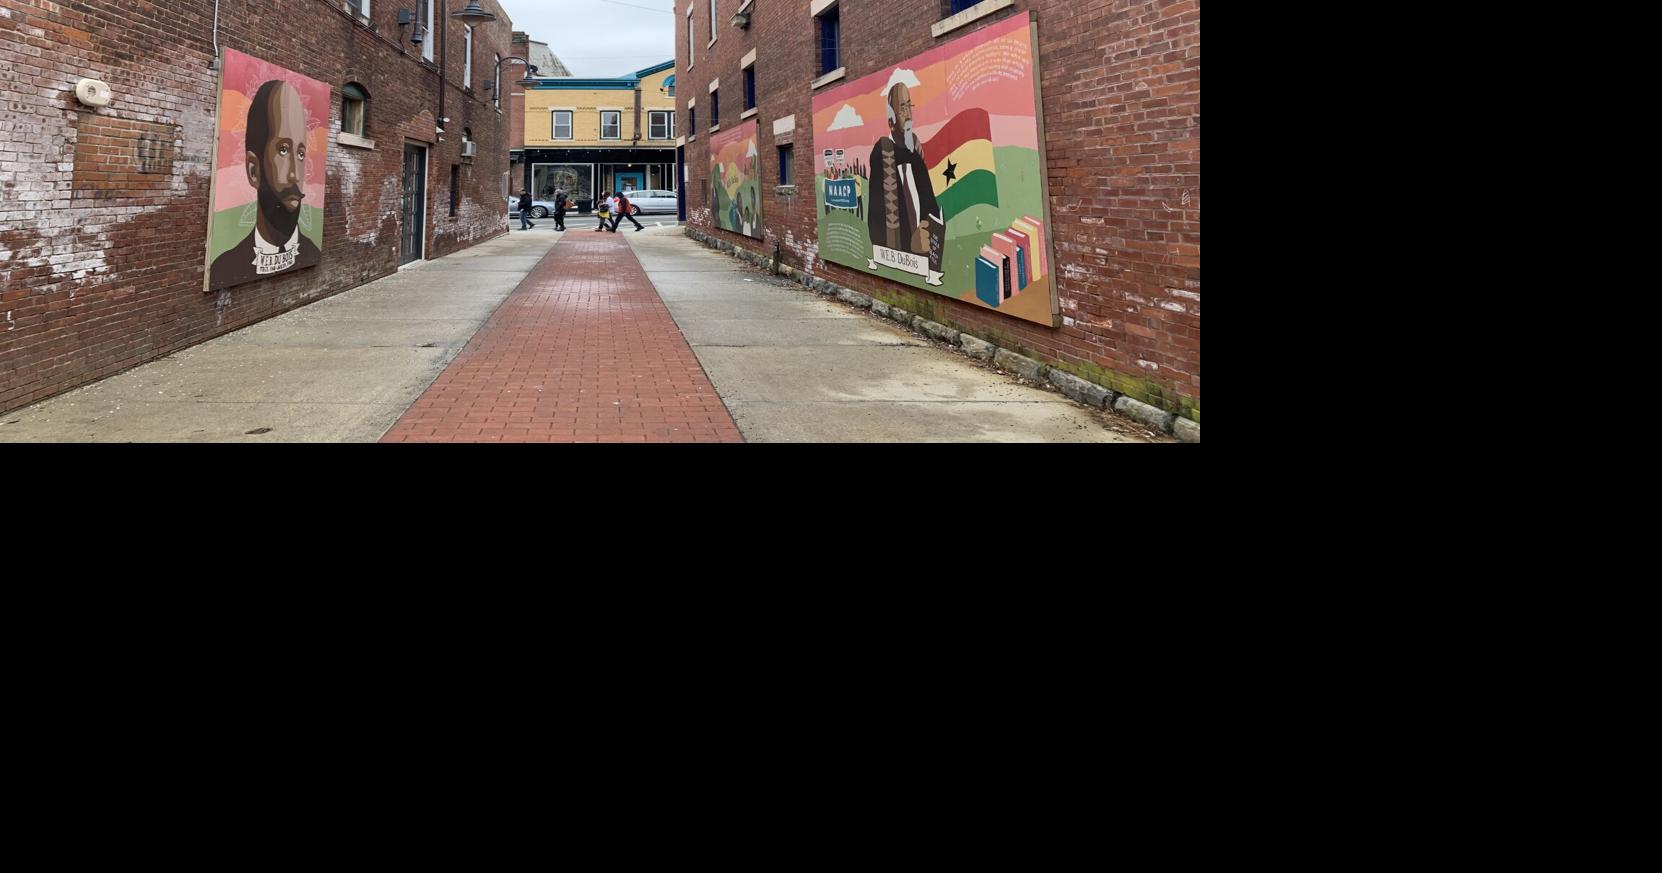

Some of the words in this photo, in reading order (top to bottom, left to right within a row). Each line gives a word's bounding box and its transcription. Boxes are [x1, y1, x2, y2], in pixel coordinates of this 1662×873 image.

[828, 185, 851, 198] NAACP
[274, 254, 282, 265] DU
[282, 251, 293, 263] BOIS
[897, 252, 918, 268] DuBois
